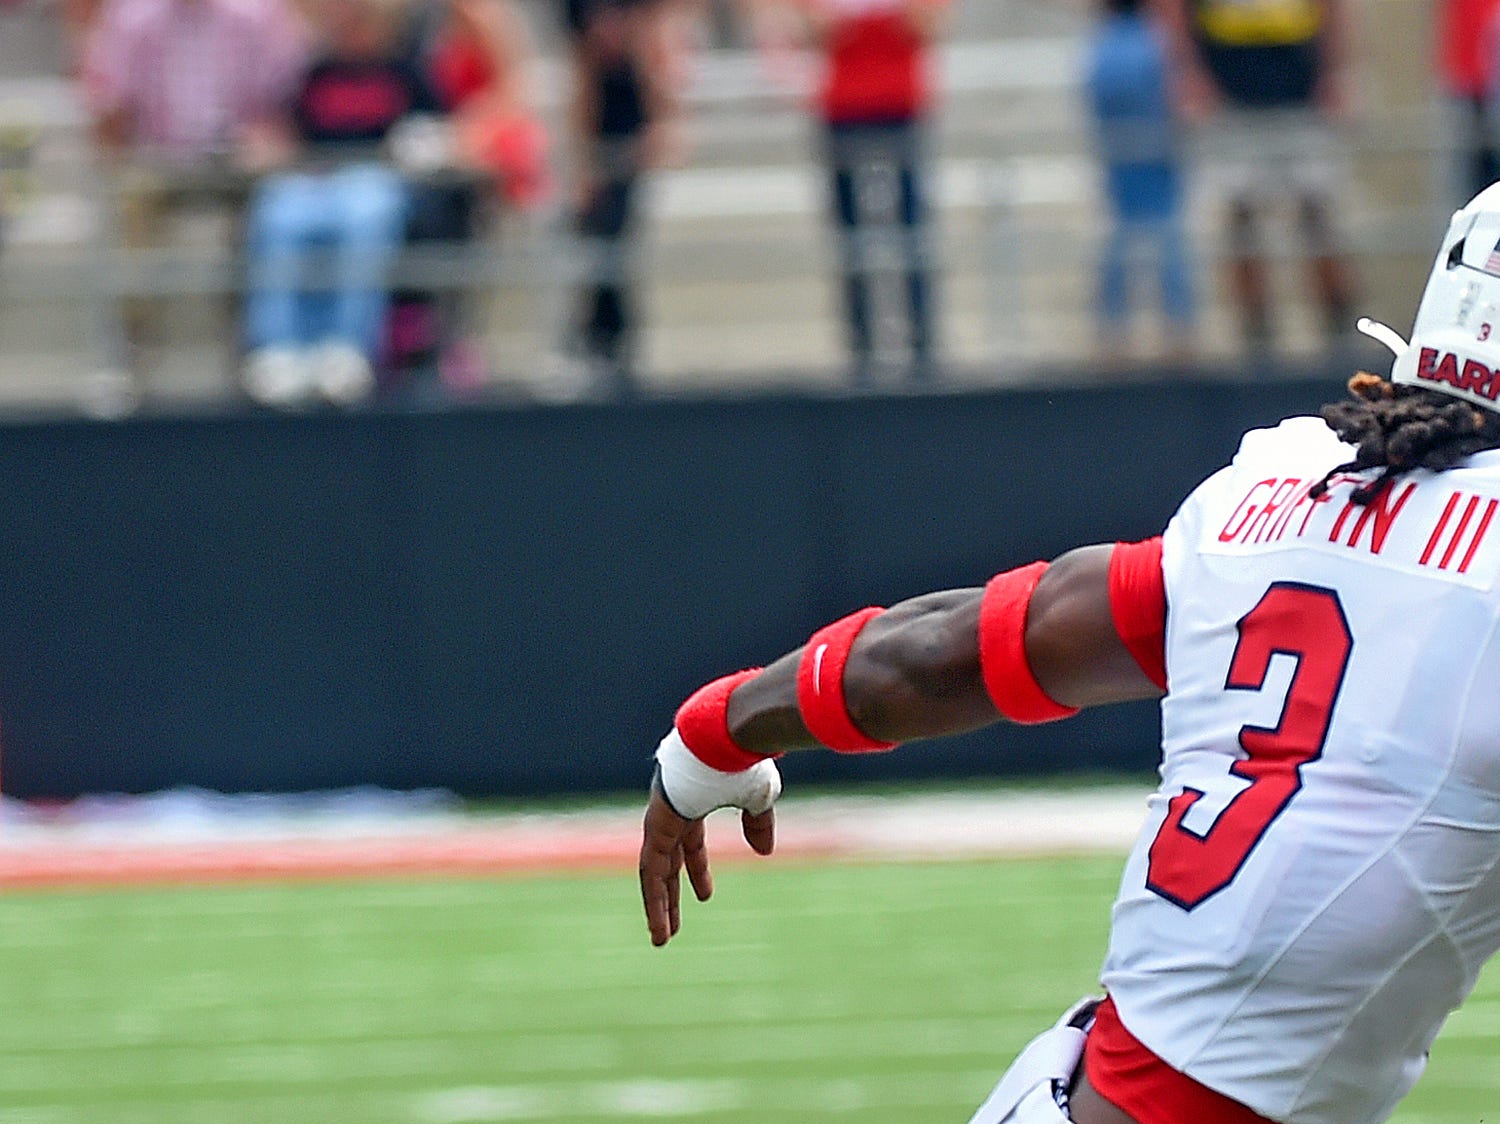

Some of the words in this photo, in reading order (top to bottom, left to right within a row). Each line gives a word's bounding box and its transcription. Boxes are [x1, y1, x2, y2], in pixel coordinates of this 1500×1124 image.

[1476, 322, 1491, 342] 3
[1418, 490, 1499, 573] III
[1145, 580, 1354, 913] 3
